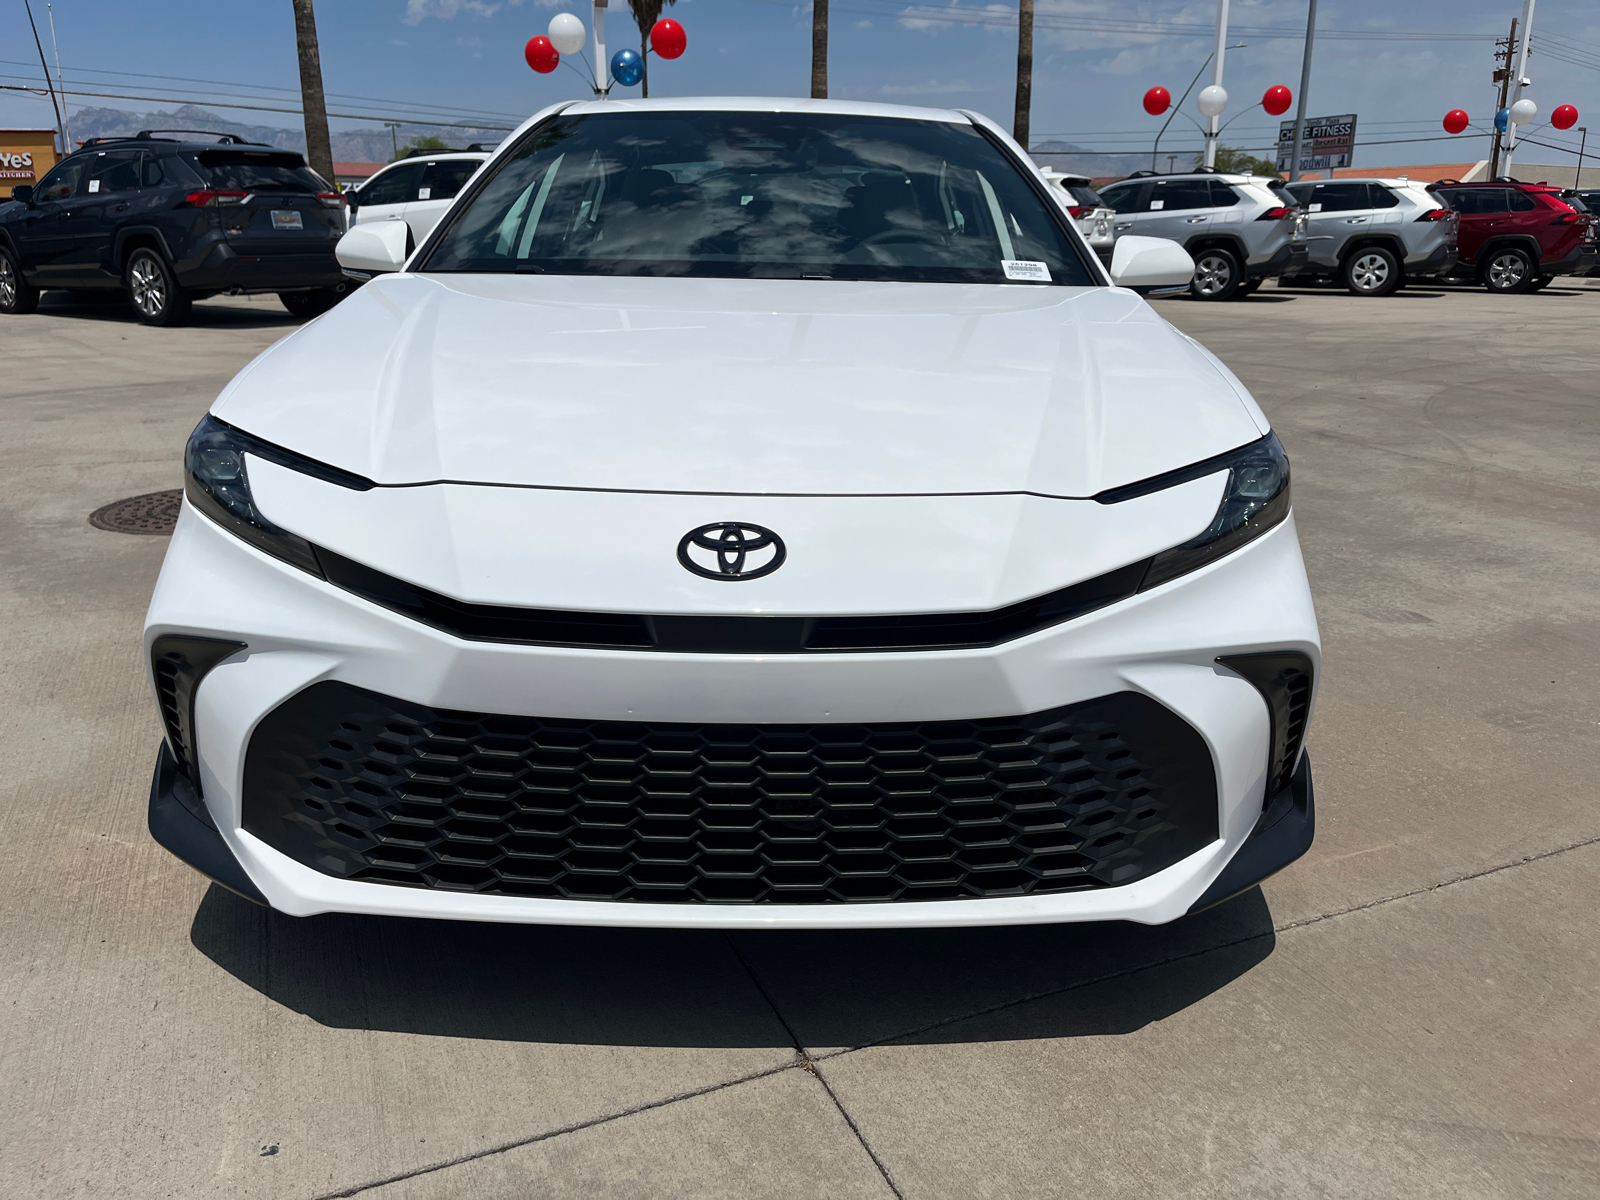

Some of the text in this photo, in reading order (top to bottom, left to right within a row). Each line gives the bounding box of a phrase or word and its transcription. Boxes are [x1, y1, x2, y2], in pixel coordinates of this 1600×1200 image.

[1280, 124, 1351, 140] CHE FITNESS
[1299, 155, 1330, 168] oodwill
